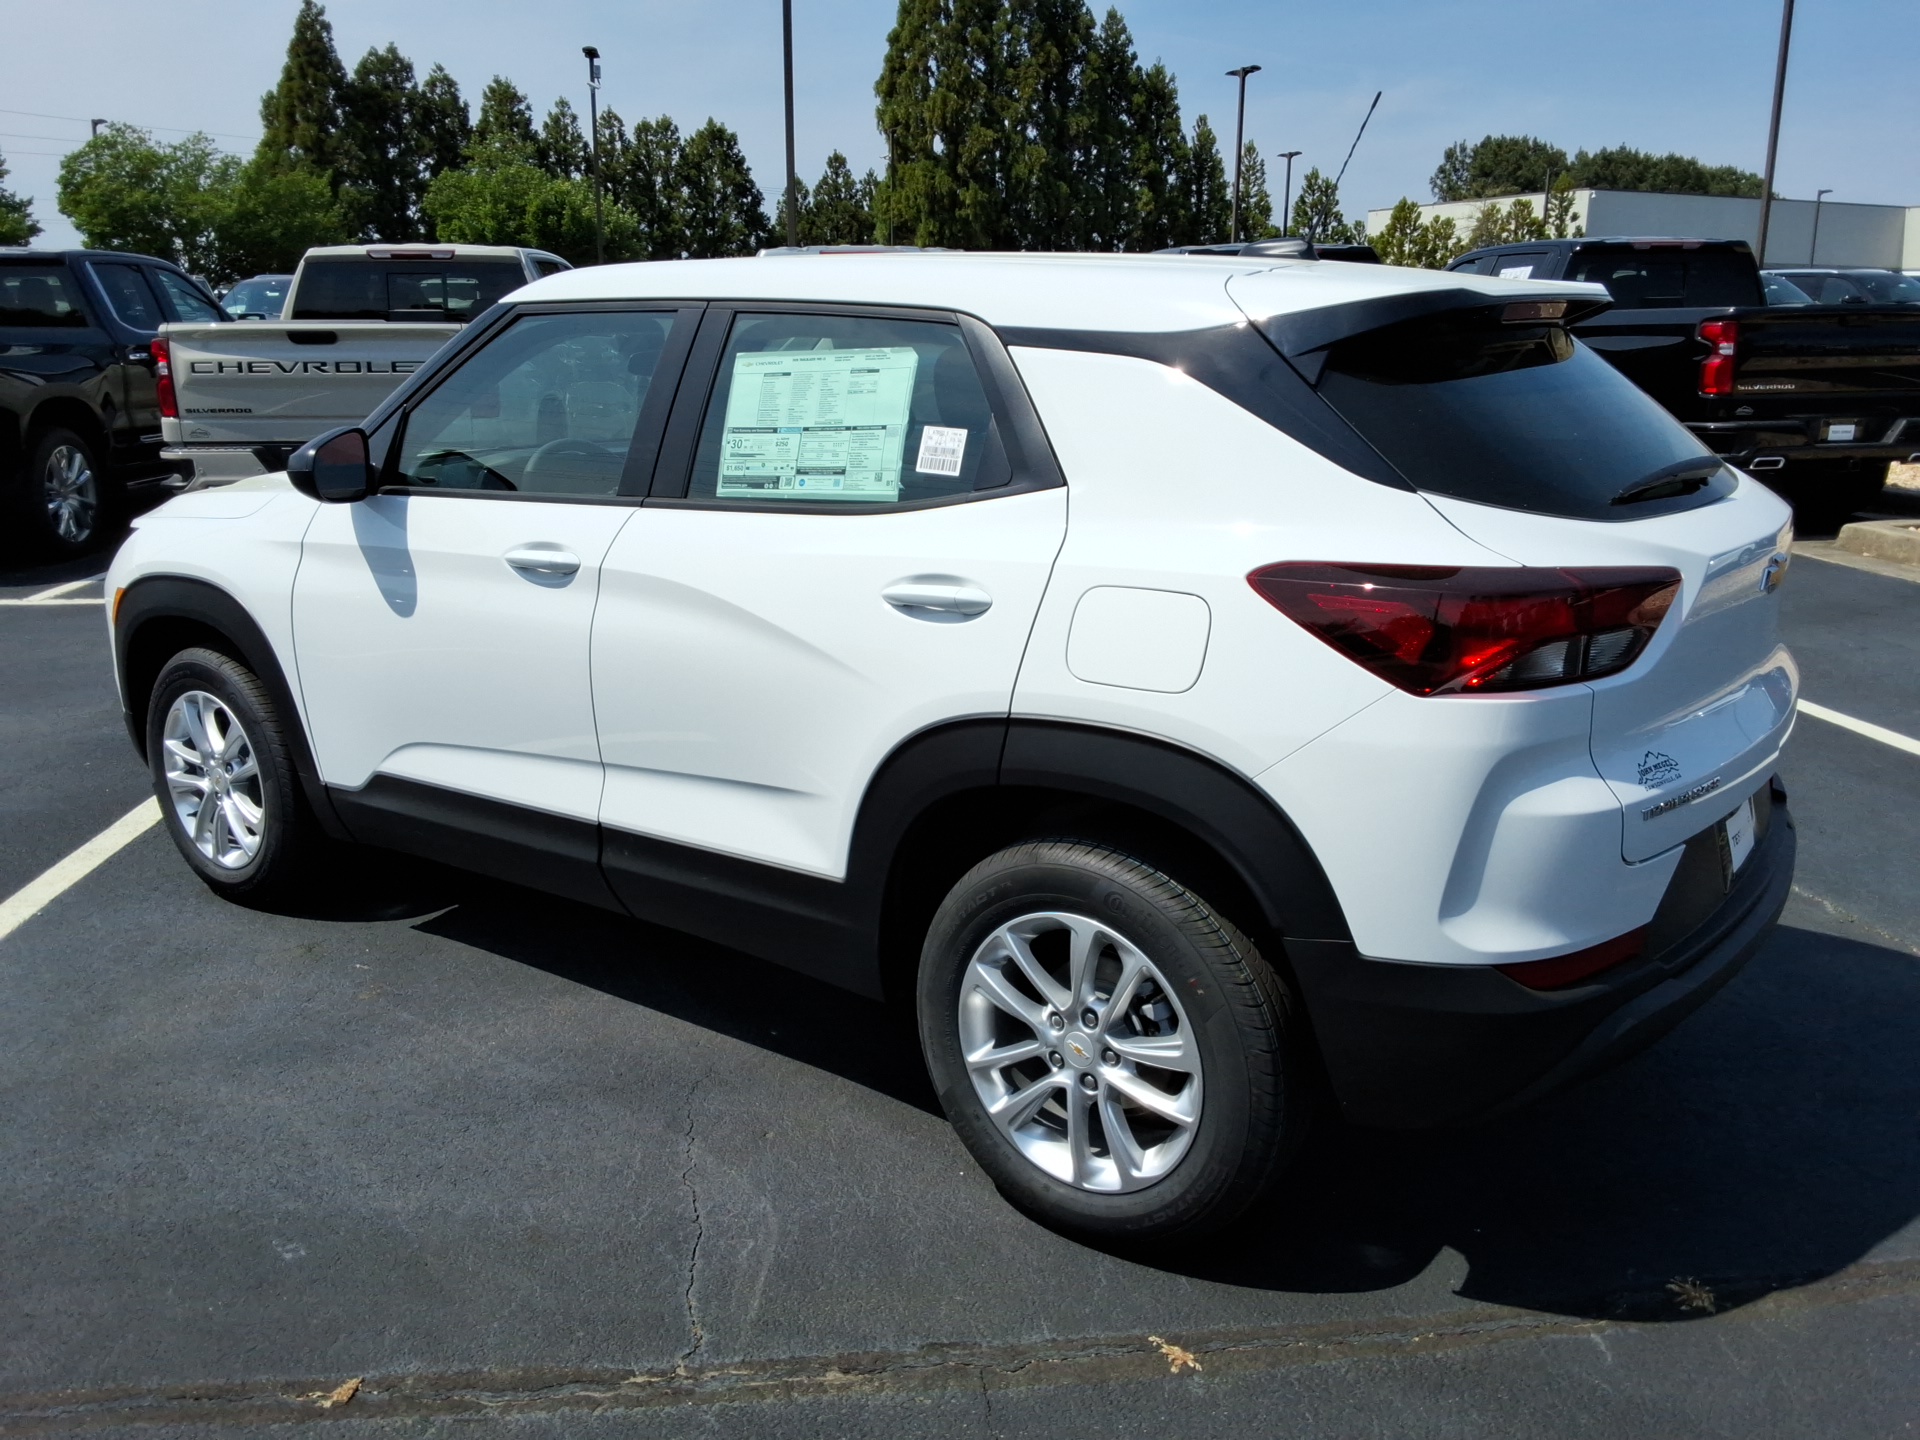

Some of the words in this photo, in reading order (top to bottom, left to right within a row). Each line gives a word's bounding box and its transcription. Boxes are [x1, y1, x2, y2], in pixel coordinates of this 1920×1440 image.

[190, 361, 426, 374] CHEVROLE
[730, 439, 743, 449] 30
[1637, 765, 1654, 785] JOHN
